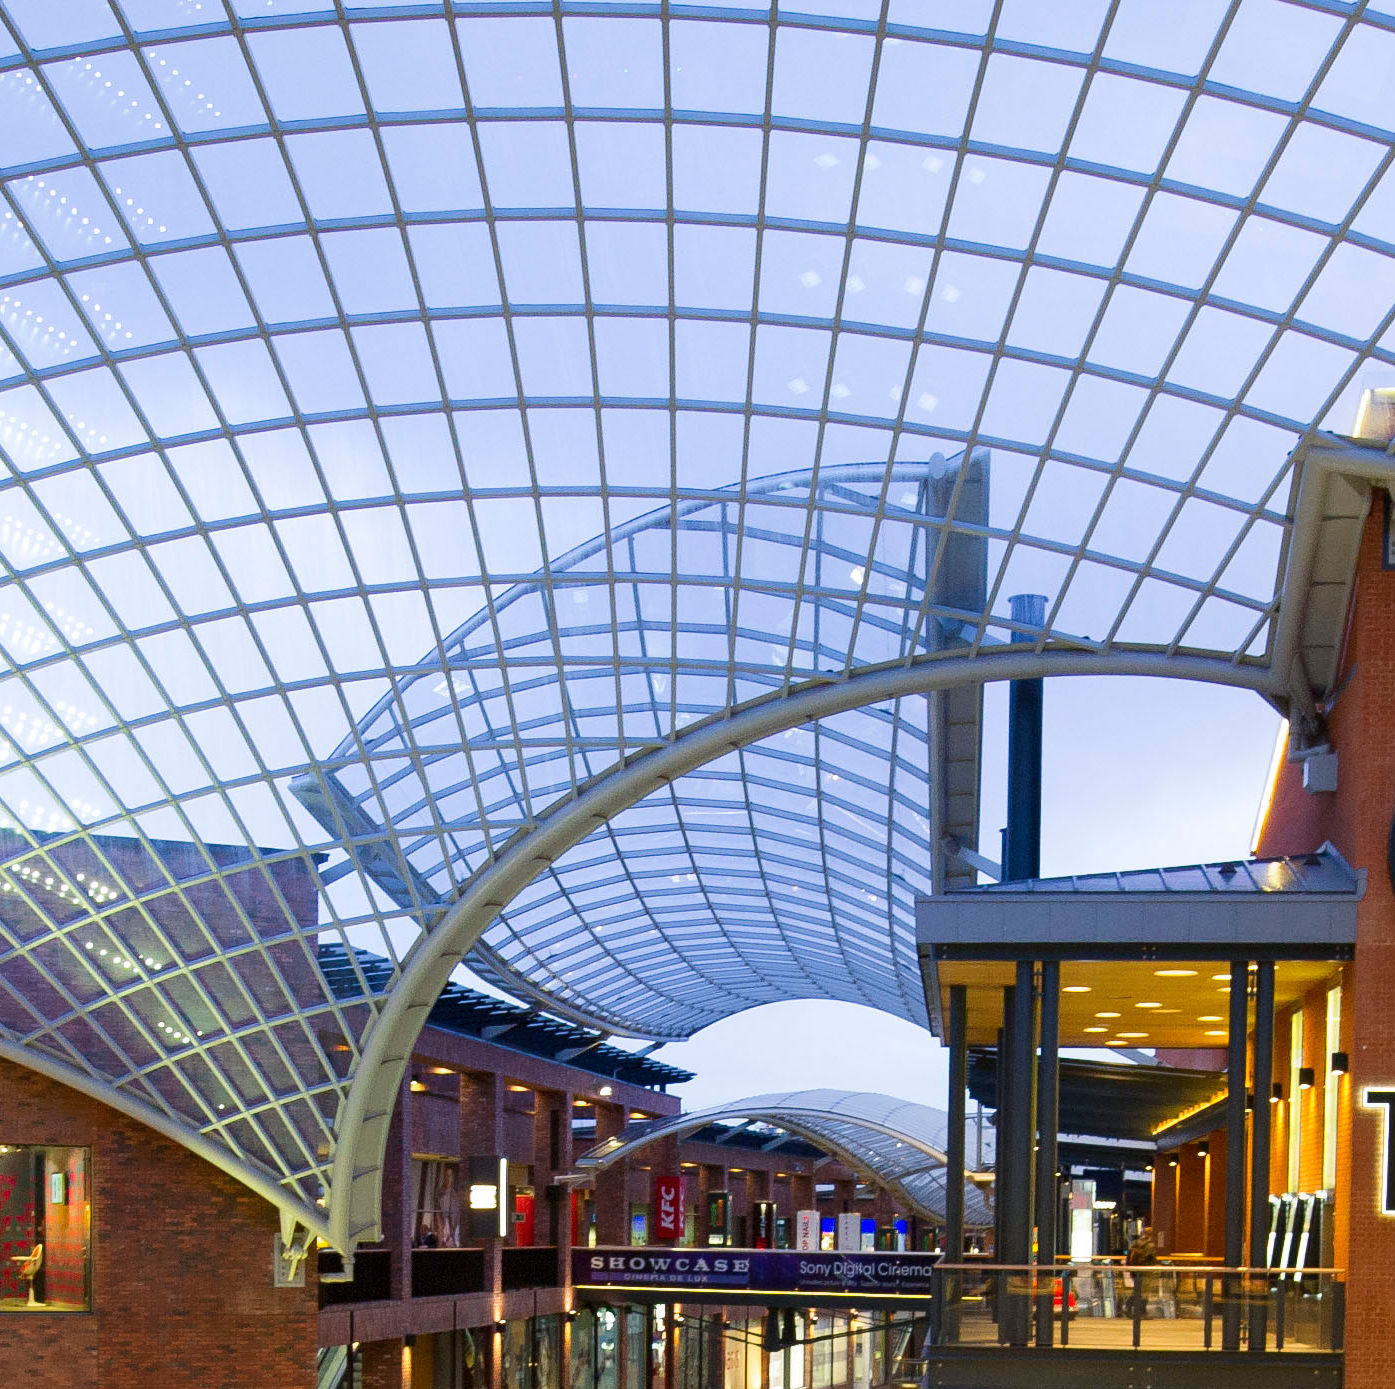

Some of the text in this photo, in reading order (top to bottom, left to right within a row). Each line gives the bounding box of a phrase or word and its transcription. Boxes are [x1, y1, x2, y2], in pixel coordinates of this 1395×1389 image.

[661, 1186, 675, 1230] KFC
[590, 1256, 750, 1273] SHOWCASE
[800, 1261, 932, 1278] Sony Digital Cinema
